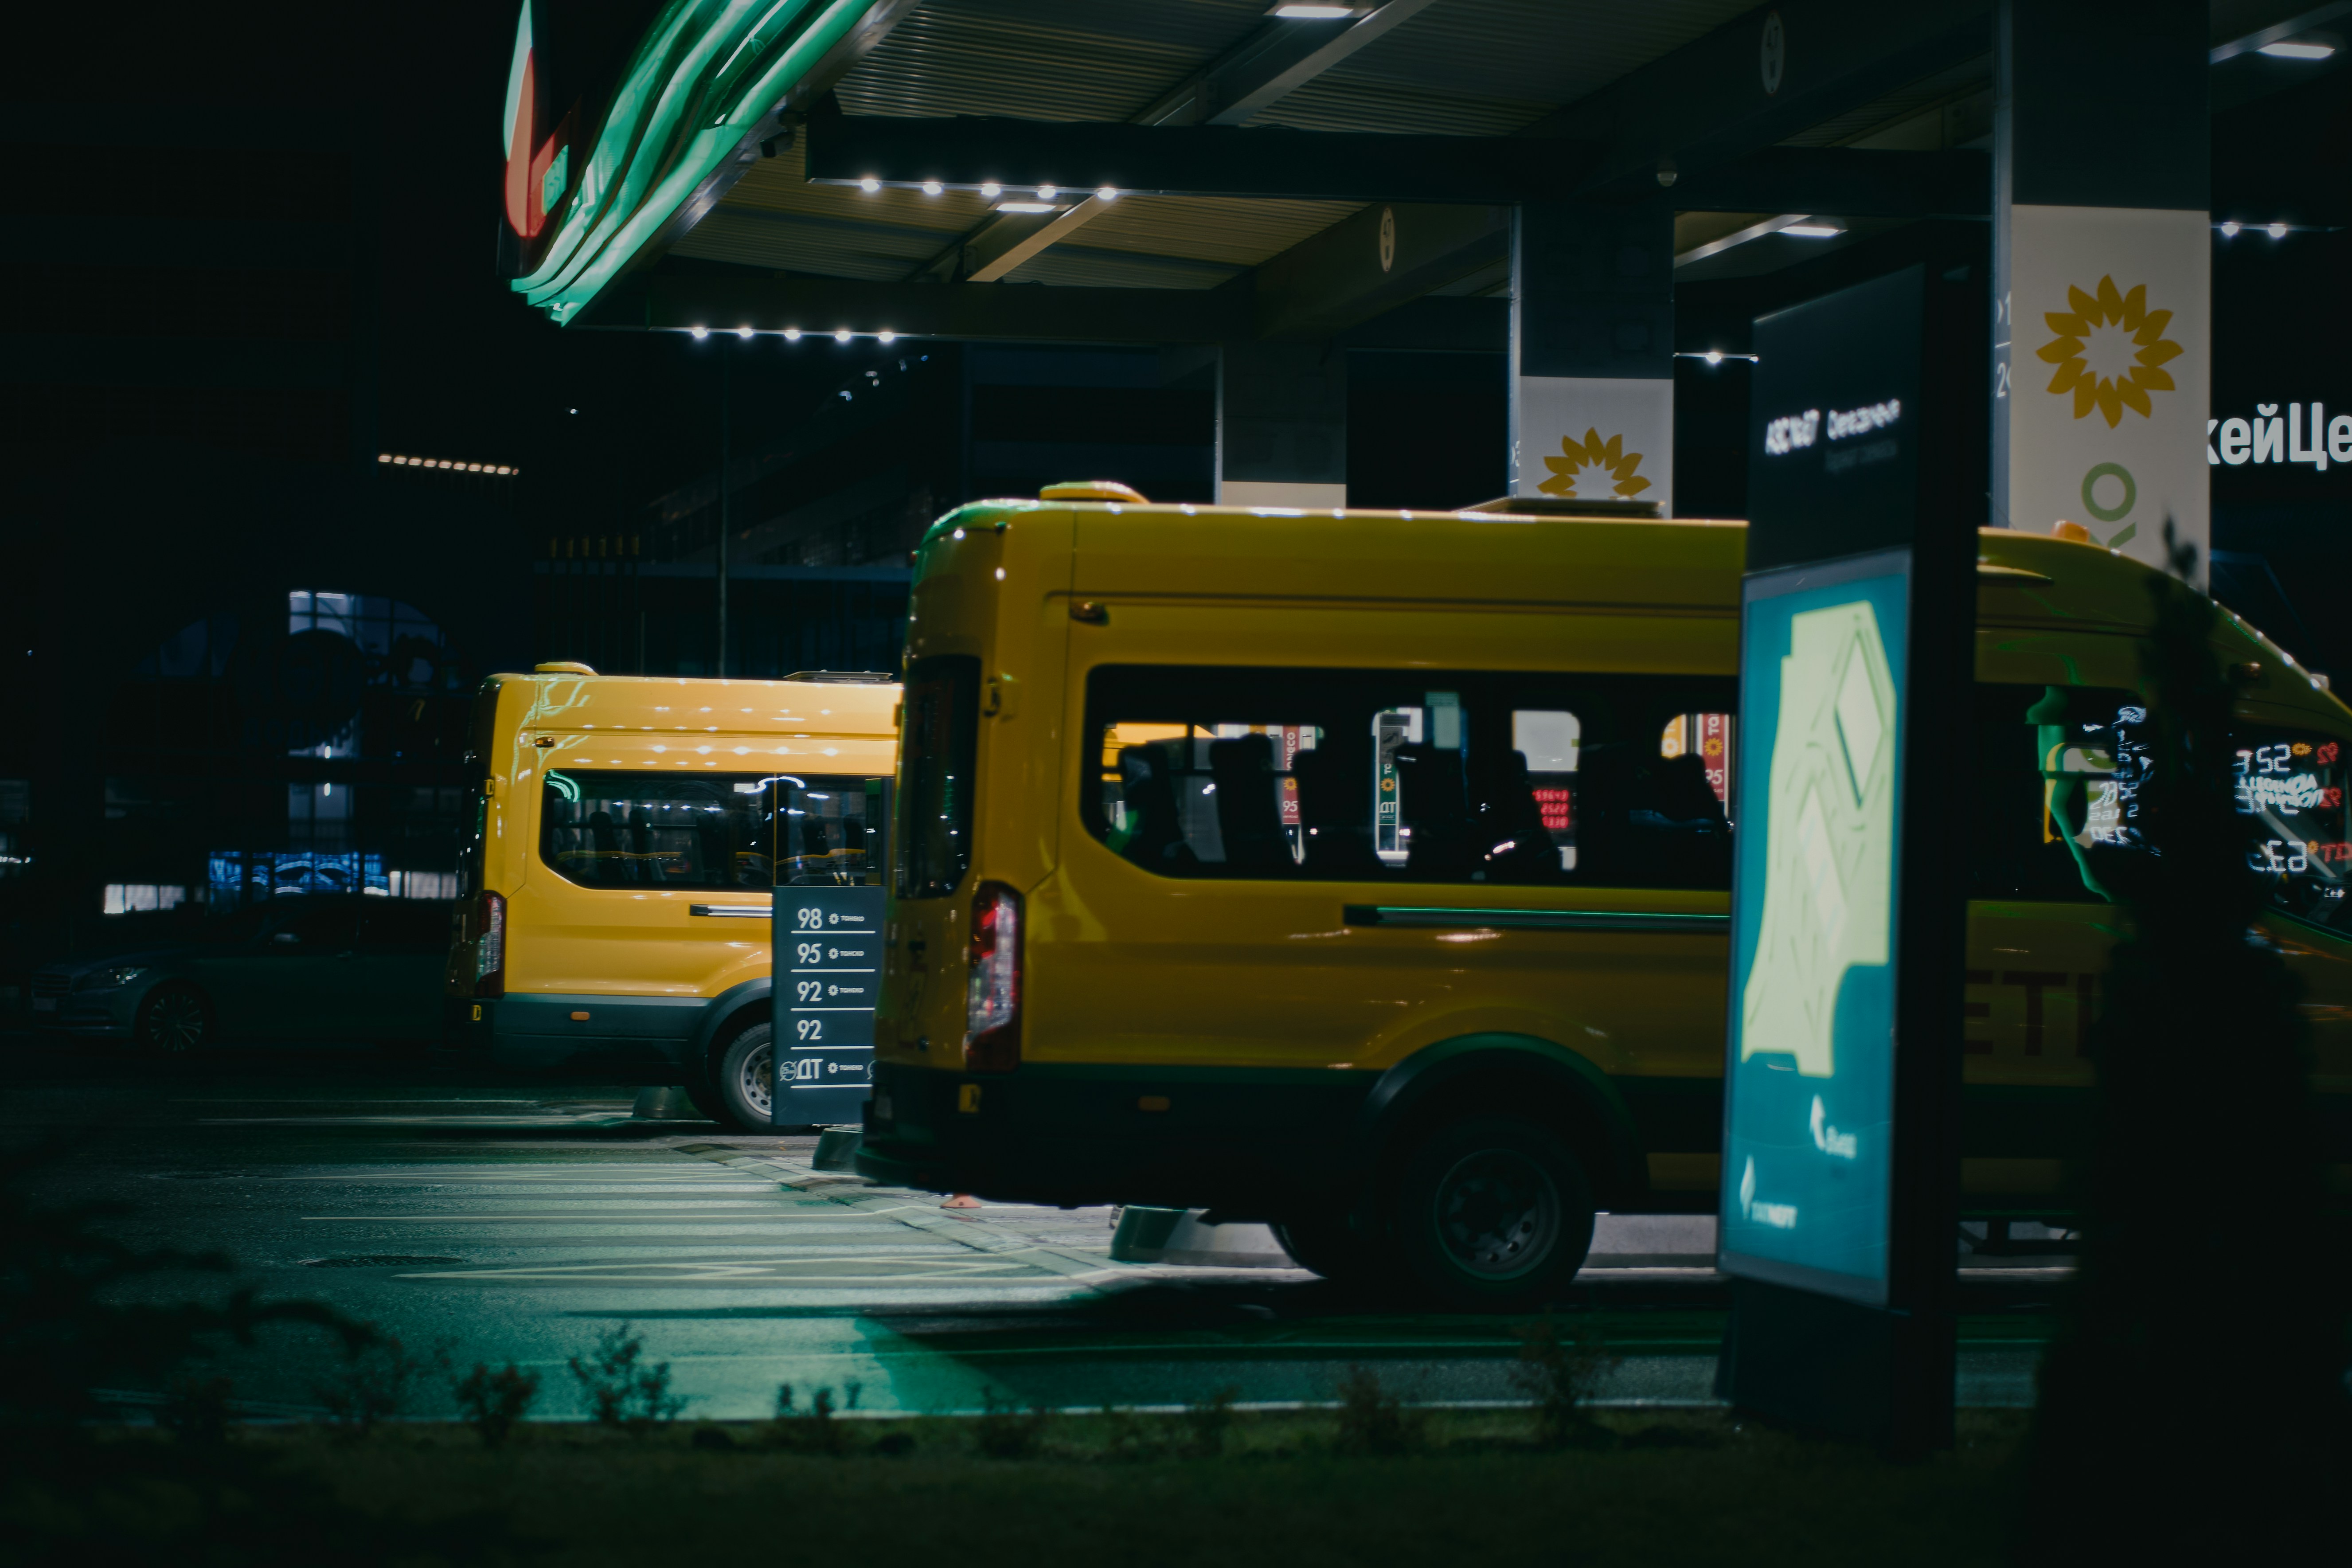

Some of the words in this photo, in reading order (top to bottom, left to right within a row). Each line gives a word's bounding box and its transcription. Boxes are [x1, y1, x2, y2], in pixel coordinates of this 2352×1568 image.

[1282, 800, 1298, 812] 95
[798, 908, 822, 929] 98
[798, 943, 822, 964] 95
[797, 981, 822, 1002] 92
[797, 1020, 822, 1040] 92
[796, 1058, 824, 1079] ДТ
